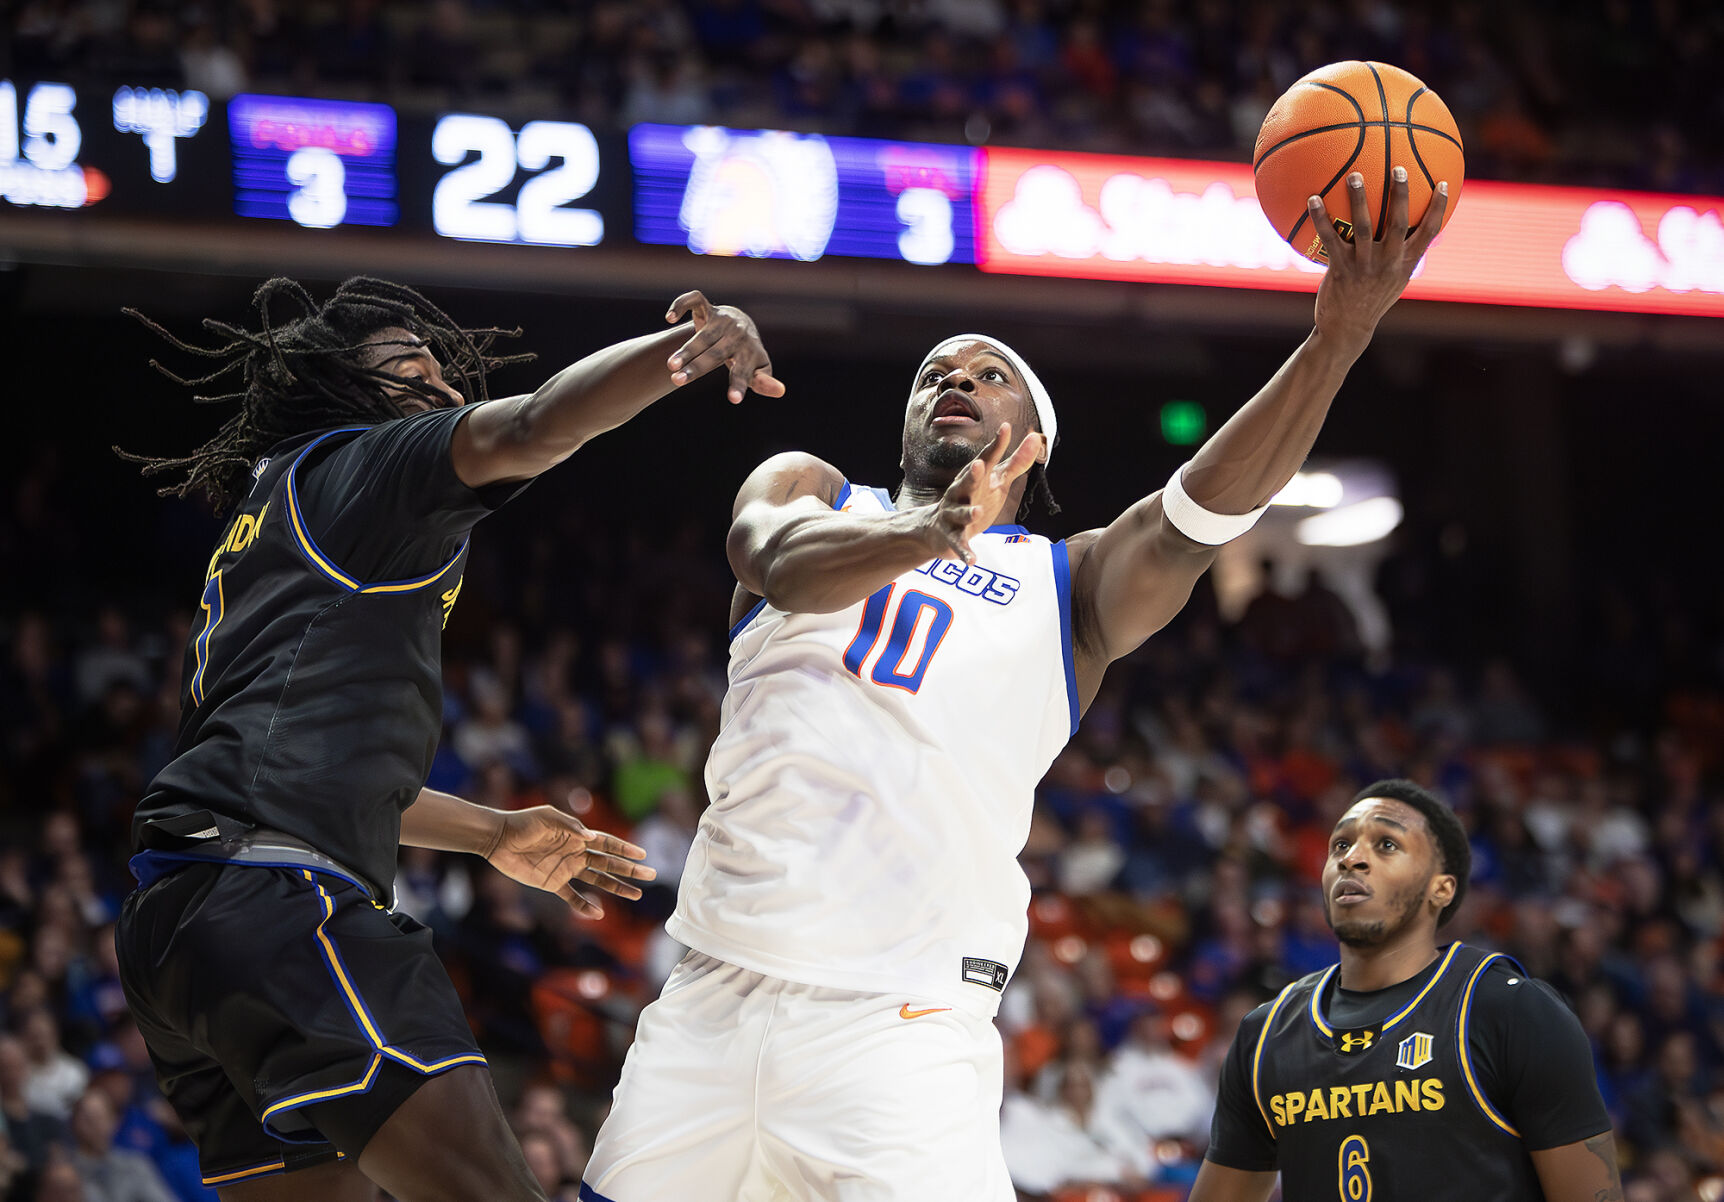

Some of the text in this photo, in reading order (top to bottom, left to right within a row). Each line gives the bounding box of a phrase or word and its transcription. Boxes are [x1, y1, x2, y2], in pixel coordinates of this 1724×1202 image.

[286, 146, 347, 228] 3
[432, 114, 604, 246] 22
[897, 186, 954, 265] 3
[913, 557, 1021, 606] COS
[191, 568, 224, 707] 1
[842, 582, 954, 695] 10
[995, 971, 1004, 985] XL
[1270, 1078, 1445, 1127] SPARTANS
[1338, 1134, 1372, 1202] 6
